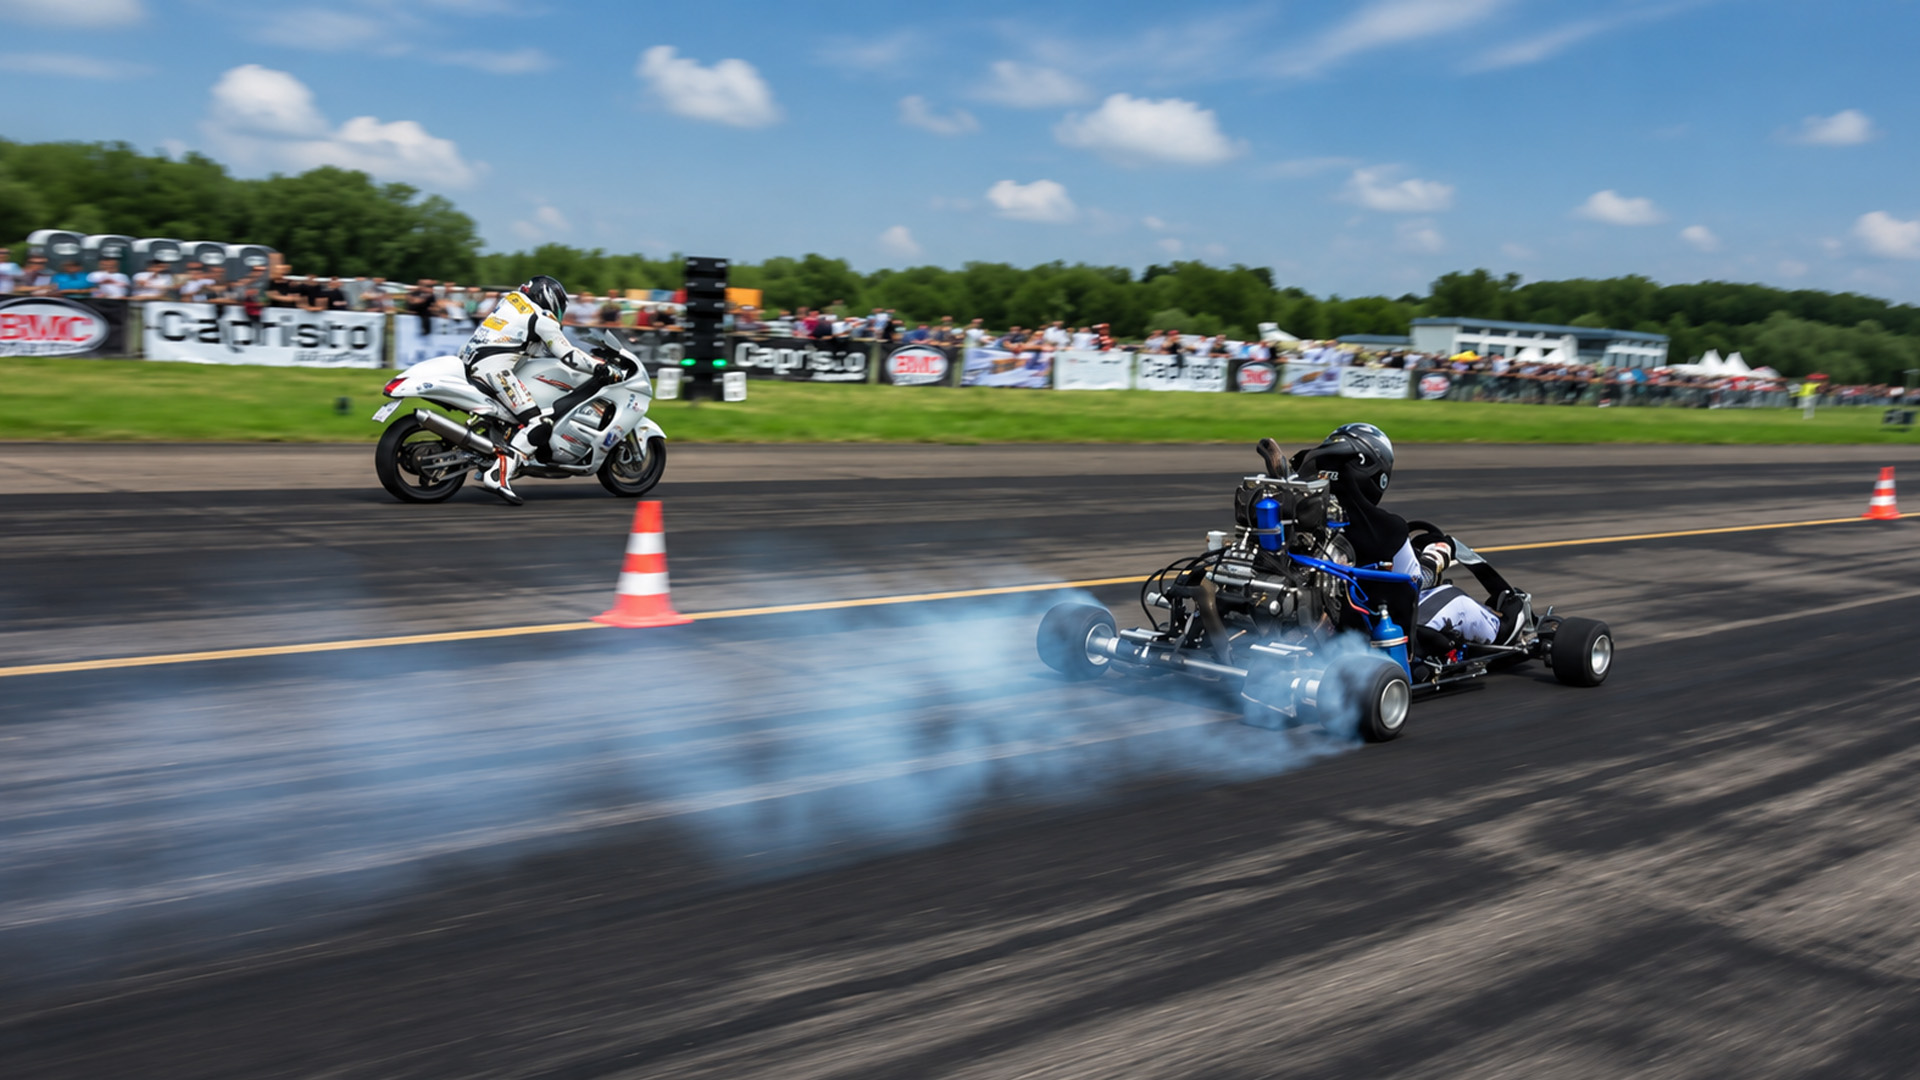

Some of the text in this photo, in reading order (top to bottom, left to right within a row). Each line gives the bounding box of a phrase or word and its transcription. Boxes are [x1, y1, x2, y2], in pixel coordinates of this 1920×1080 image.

[157, 305, 374, 353] Capristo
[735, 342, 867, 375] Capristo
[892, 354, 942, 375] BMC
